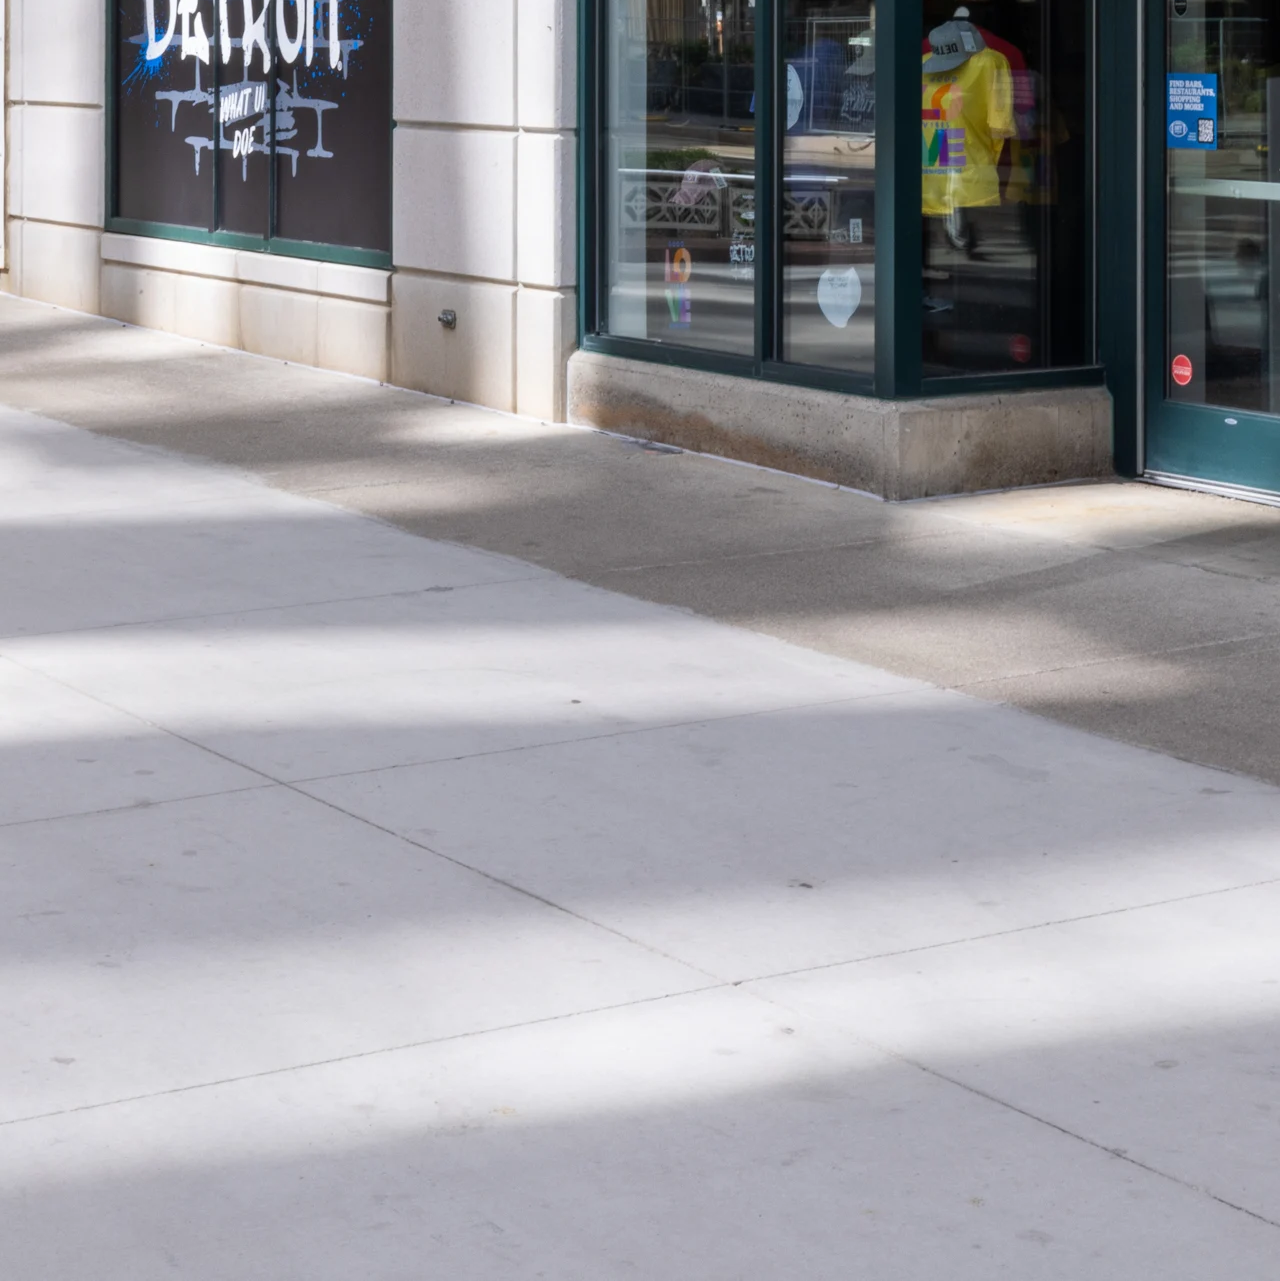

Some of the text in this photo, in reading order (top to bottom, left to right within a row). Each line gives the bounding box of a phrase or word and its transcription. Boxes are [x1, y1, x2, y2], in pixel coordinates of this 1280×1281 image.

[1169, 80, 1185, 88] FIND
[1169, 95, 1201, 103] SHOPPING
[220, 87, 252, 123] WHAT
[1169, 103, 1184, 111] AND
[232, 125, 256, 159] DOE
